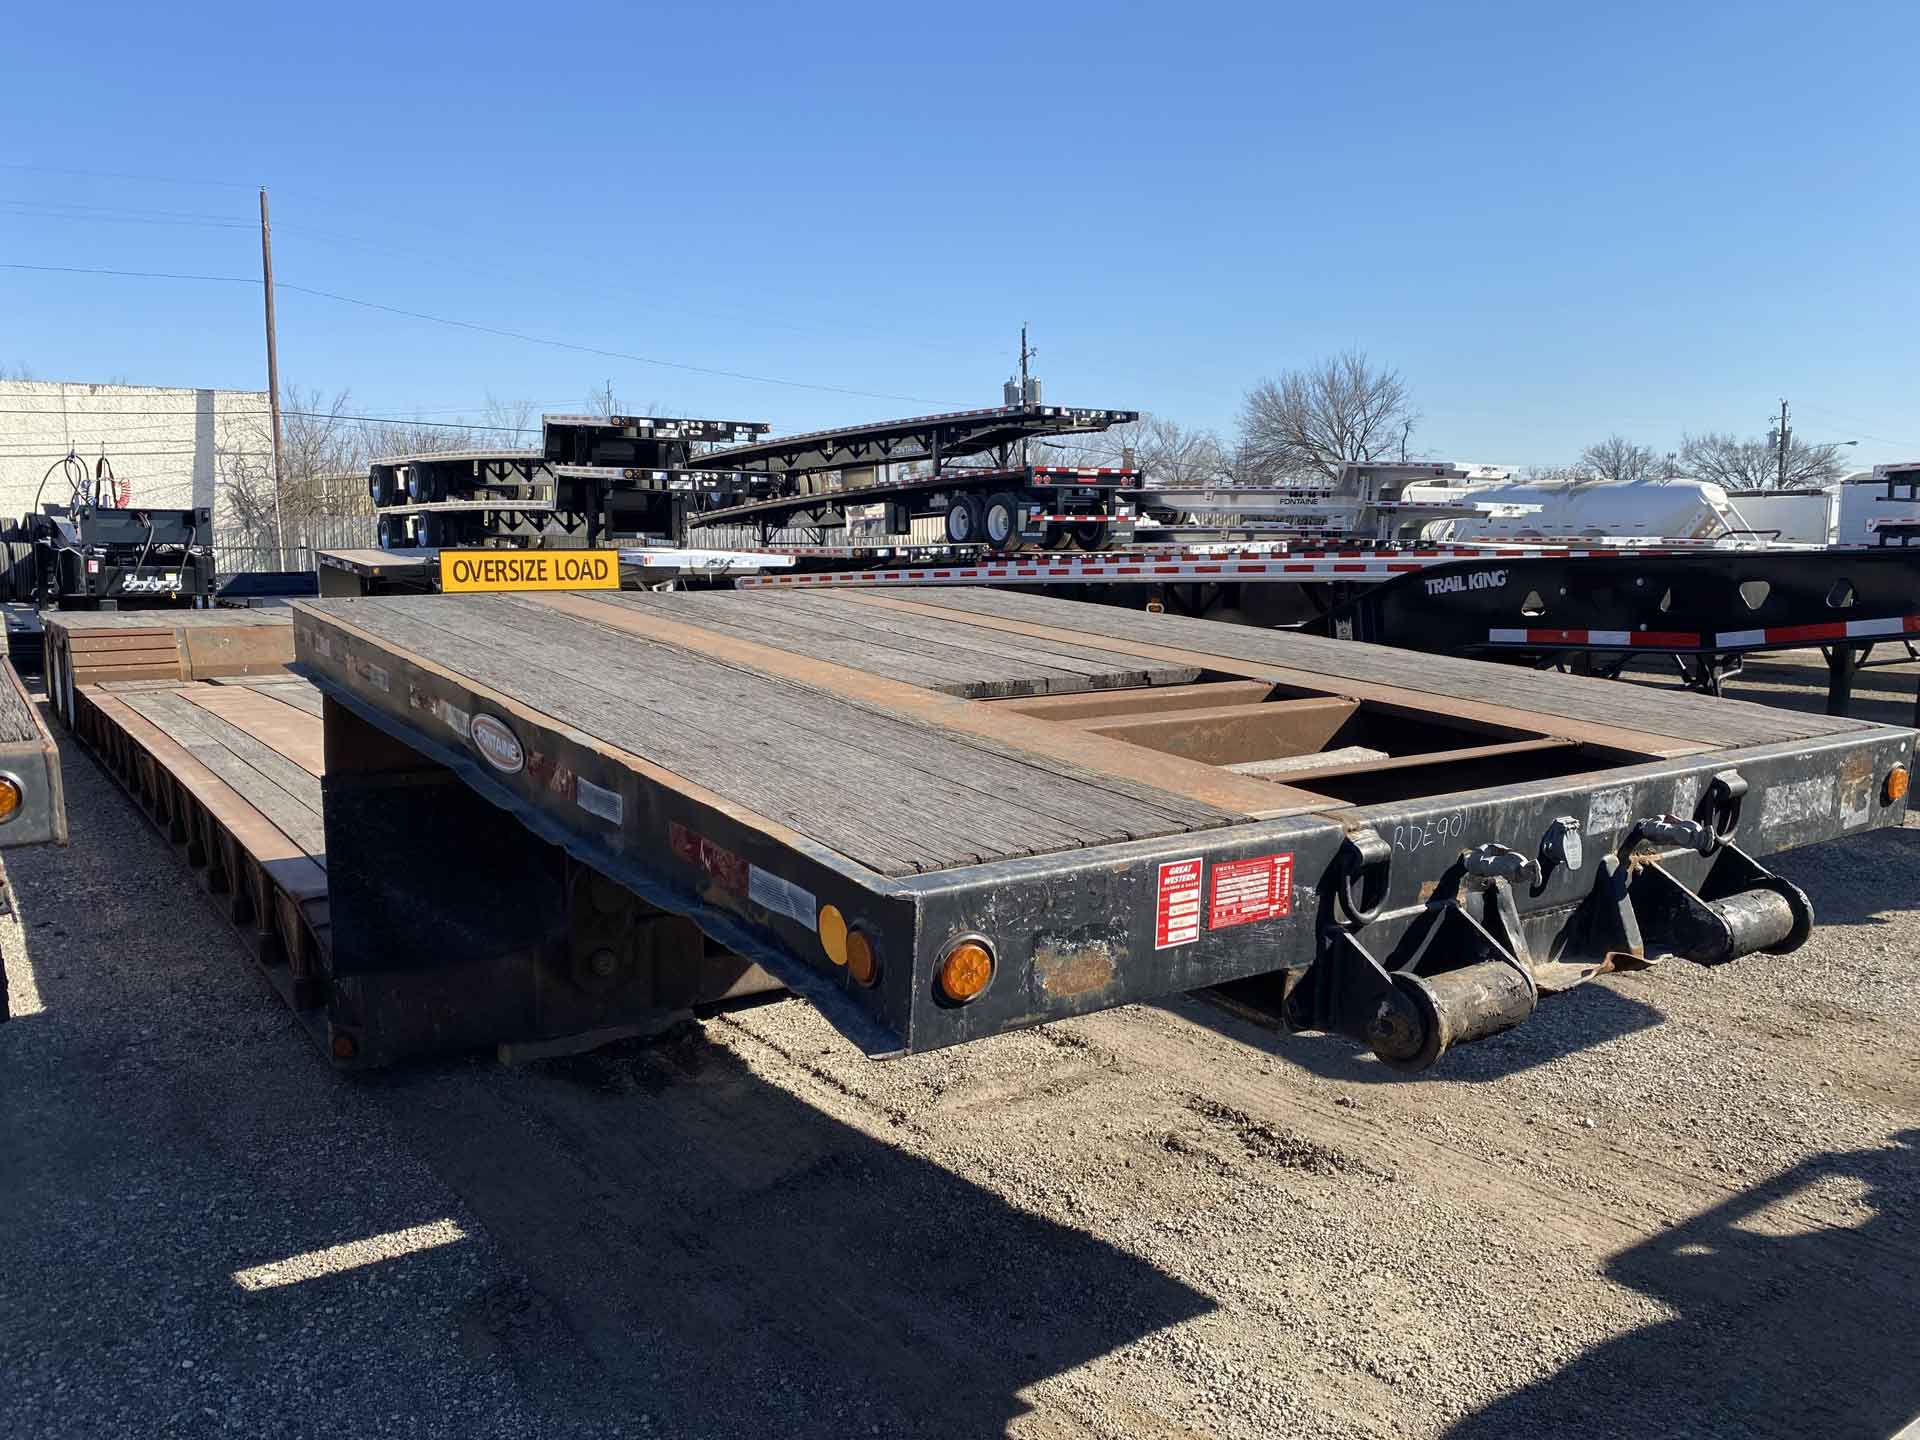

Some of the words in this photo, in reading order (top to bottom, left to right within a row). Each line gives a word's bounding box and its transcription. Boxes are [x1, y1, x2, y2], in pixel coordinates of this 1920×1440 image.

[453, 559, 548, 583] OVERSIZE
[555, 559, 608, 581] LOAD
[477, 725, 518, 761] FONTAINE
[1164, 872, 1198, 885] WESTERN
[1168, 864, 1193, 876] GREAT
